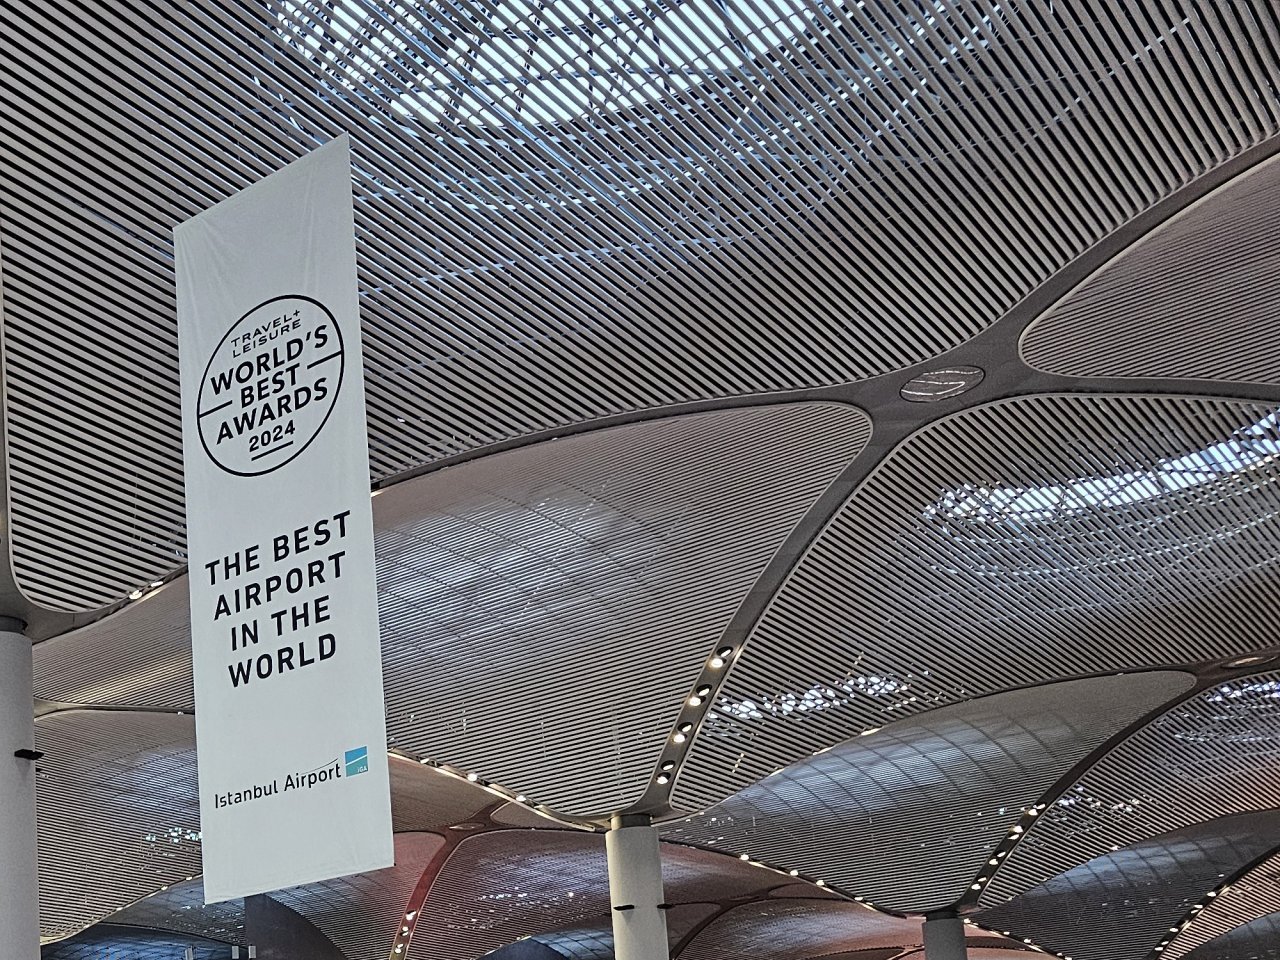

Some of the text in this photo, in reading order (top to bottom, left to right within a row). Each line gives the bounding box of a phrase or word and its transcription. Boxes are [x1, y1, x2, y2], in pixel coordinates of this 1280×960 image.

[231, 309, 301, 346] TRAVEL+
[232, 319, 301, 358] LEISURE
[210, 324, 328, 396] WORLD'S
[241, 363, 301, 409] BEST
[216, 377, 328, 445] AWARDS
[248, 420, 296, 452] 2024
[205, 510, 351, 586] THE BEST
[214, 550, 346, 621] AIRPORT
[231, 595, 331, 651] IN THE
[228, 633, 336, 688] WORLD
[214, 761, 341, 809] Istanbul Airport
